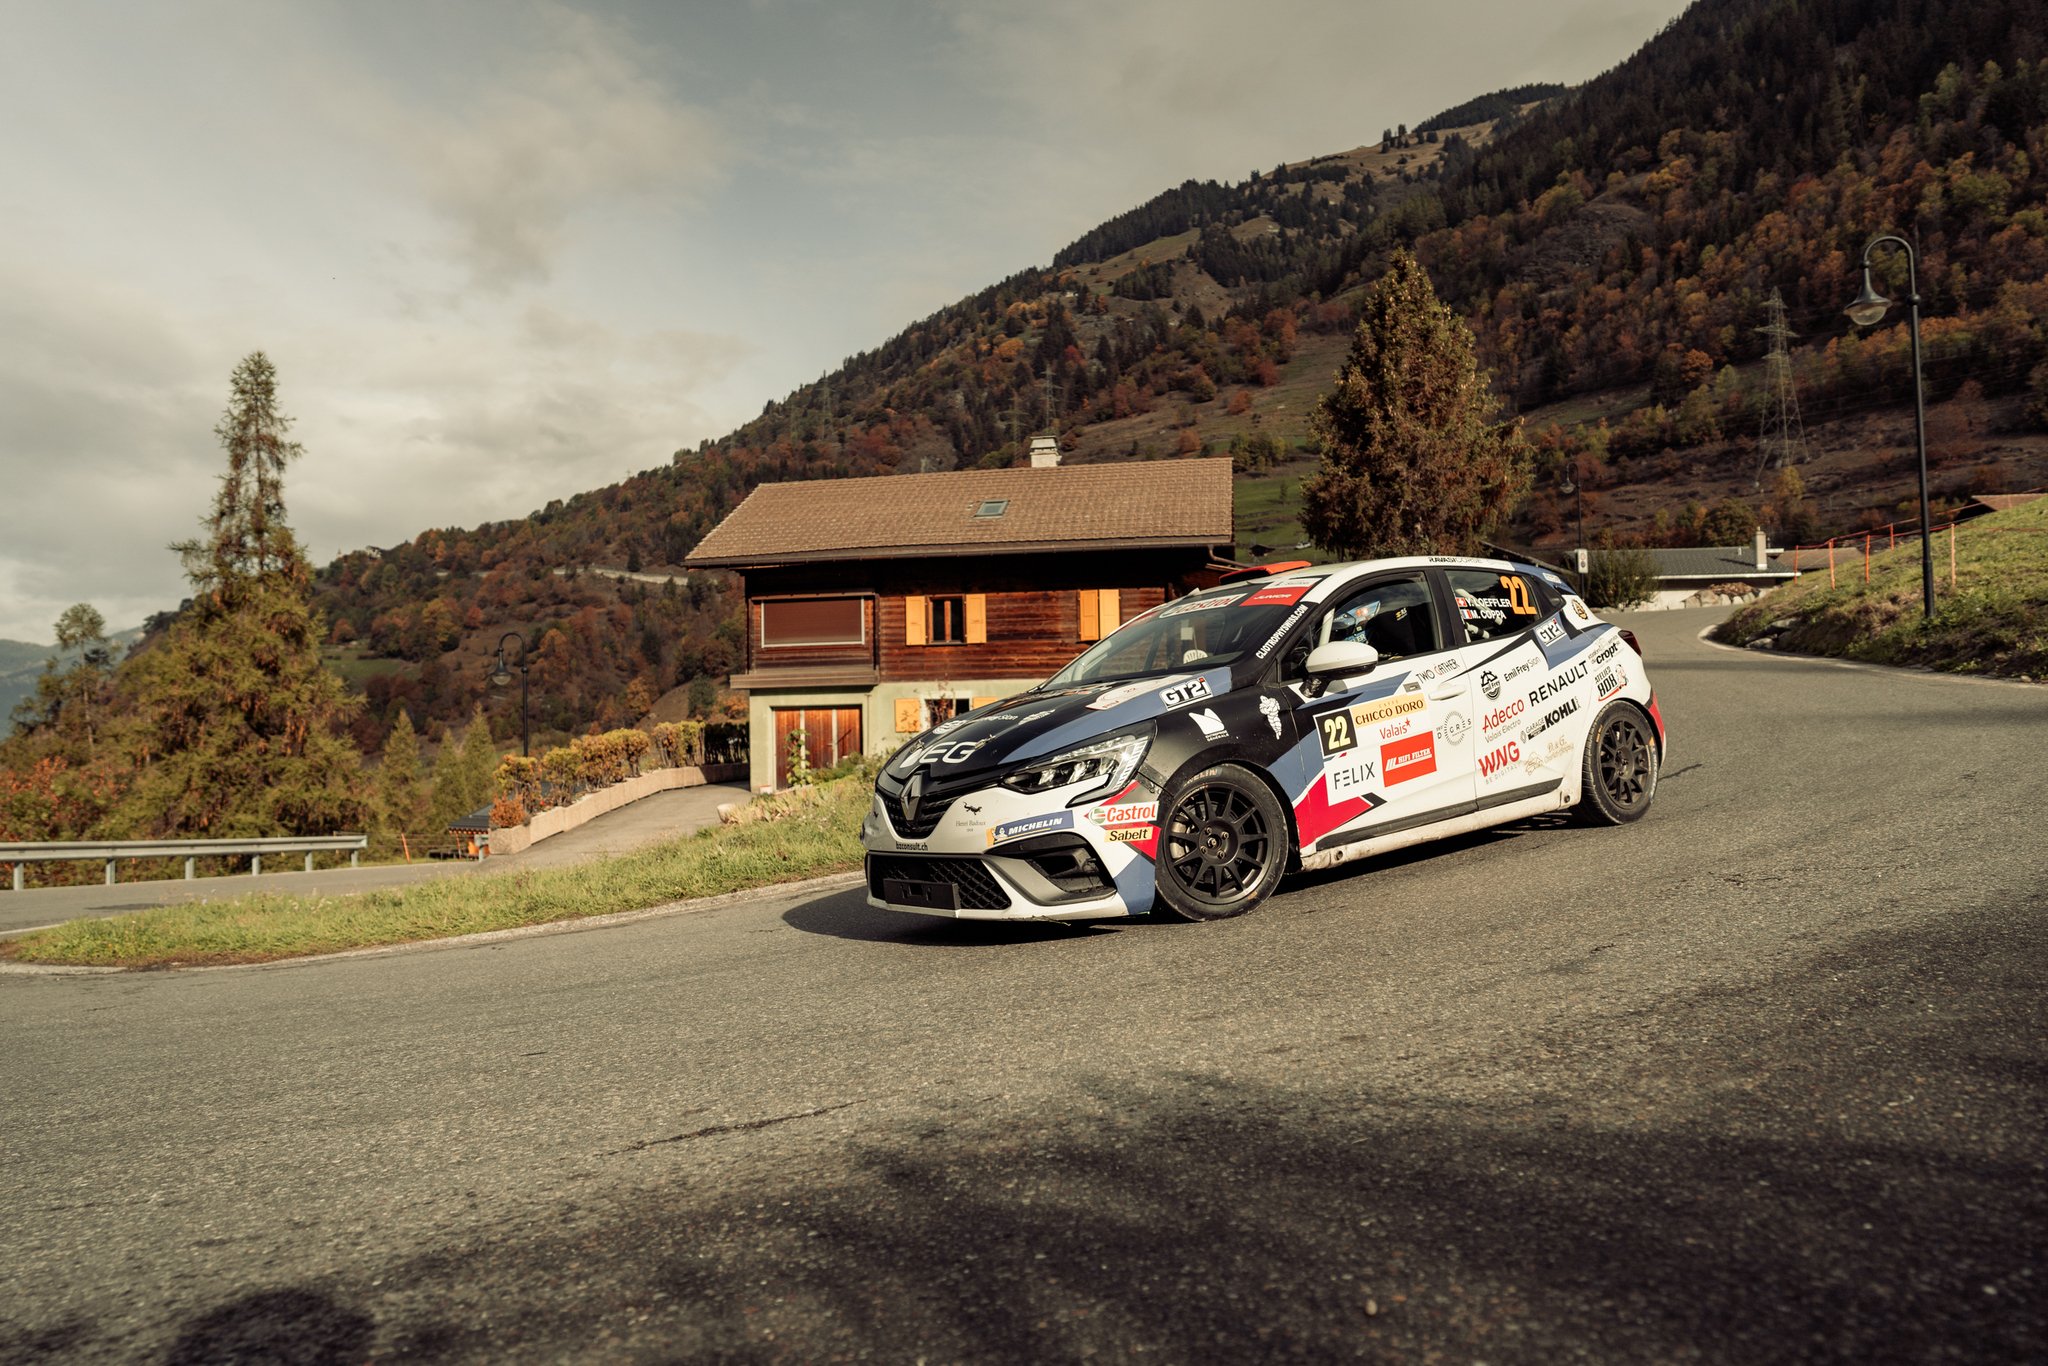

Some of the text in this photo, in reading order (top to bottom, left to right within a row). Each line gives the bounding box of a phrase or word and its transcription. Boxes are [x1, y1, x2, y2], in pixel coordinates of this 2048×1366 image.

[1465, 598, 1513, 608] Y. LOEFFLER
[1499, 575, 1538, 615] 22
[1471, 609, 1507, 620] M. COPPA
[1255, 603, 1309, 660] CLIOTROPHYSWISS.COM
[1596, 643, 1619, 664] cropt
[1415, 669, 1436, 684] TWO
[1504, 656, 1542, 682] Emil Frey Sion
[1594, 666, 1612, 684] ATELIER
[1160, 676, 1212, 706] GT2i
[1528, 660, 1589, 707] RENAULT
[1355, 706, 1393, 726] CHICCO
[1482, 699, 1525, 734] Adecco
[1544, 698, 1578, 728] KOHLI
[1323, 715, 1351, 751] 22
[1379, 722, 1408, 740] Valais
[1485, 729, 1502, 743] Valais
[1502, 719, 1522, 734] Electro
[1525, 717, 1545, 734] GARAGE
[1398, 748, 1431, 764] HIFI FILTER
[1477, 741, 1520, 777] WNG
[1333, 761, 1376, 790] FELIX
[1494, 765, 1518, 781] DIGITAL
[1106, 804, 1157, 822] Castrol
[1008, 817, 1063, 836] MICHELIN
[1109, 828, 1149, 842] Sabelt
